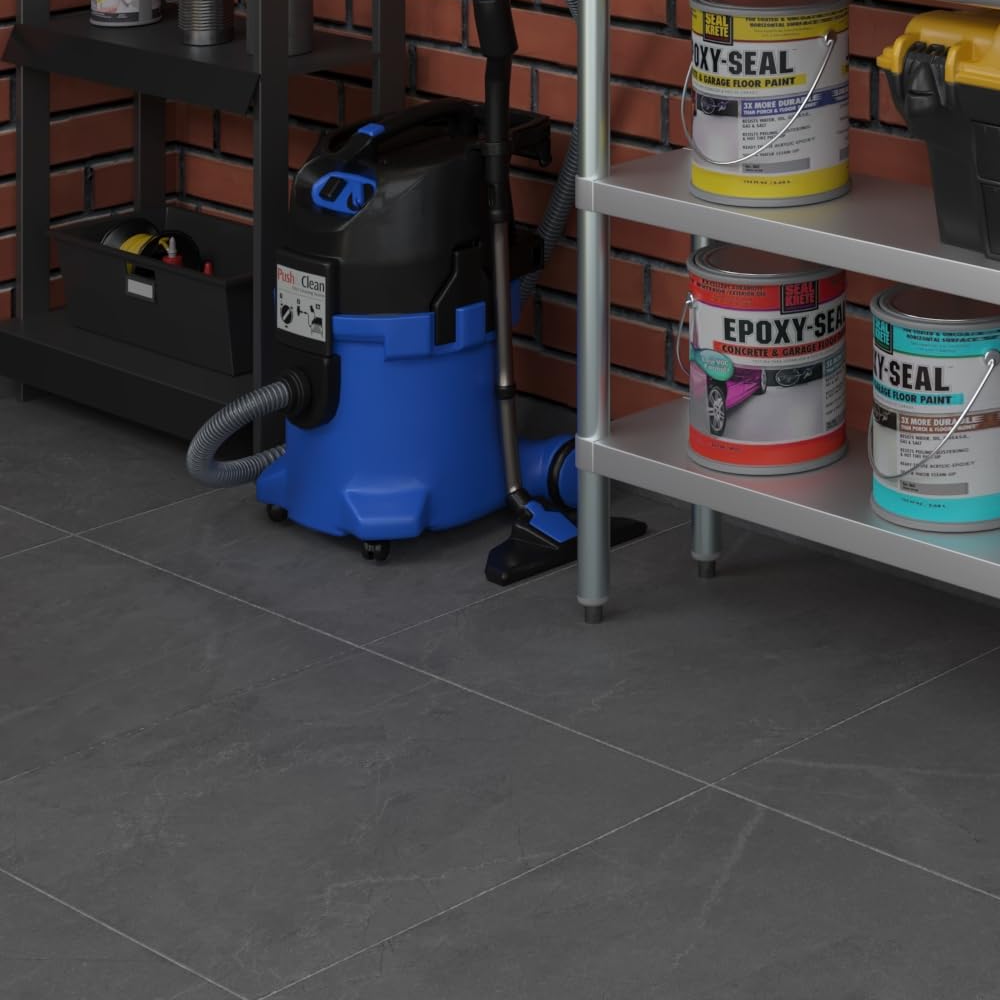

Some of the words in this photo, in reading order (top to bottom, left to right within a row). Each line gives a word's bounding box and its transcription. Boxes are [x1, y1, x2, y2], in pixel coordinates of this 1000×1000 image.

[705, 12, 729, 26] SEAL
[705, 25, 729, 38] KRETE
[693, 42, 794, 76] OXY-SEAL
[704, 75, 730, 87] GARAGE
[733, 79, 761, 88] FLOOR
[765, 76, 796, 87] PAINT
[743, 102, 752, 110] 3X
[754, 101, 776, 109] MORE
[778, 95, 818, 107] DURALE
[277, 267, 295, 285] Push
[301, 275, 325, 292] Clean
[785, 282, 814, 295] SEAL
[785, 292, 814, 306] KRETE
[722, 343, 768, 357] CONCRETE
[783, 345, 817, 356] GARAGE
[892, 388, 917, 402] FLOOR
[921, 395, 952, 404] PAINT
[910, 417, 931, 425] MORE
[934, 416, 979, 426] DURALE
